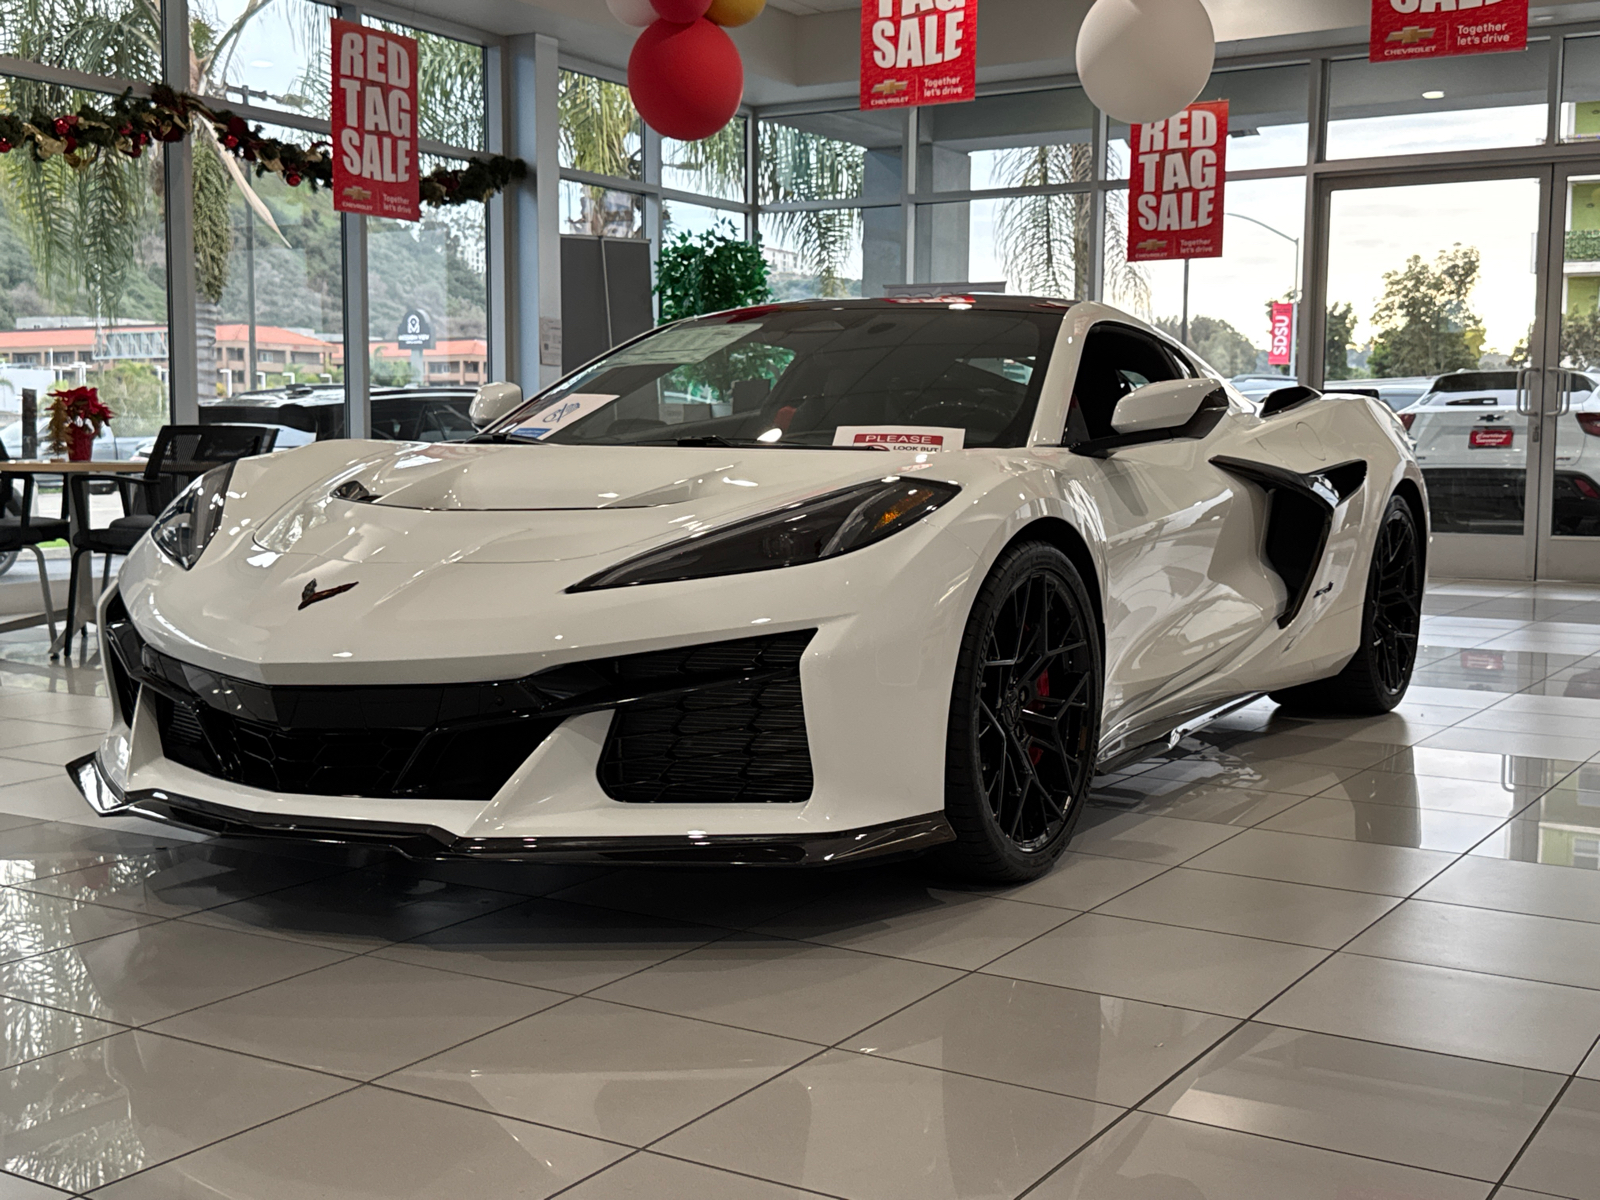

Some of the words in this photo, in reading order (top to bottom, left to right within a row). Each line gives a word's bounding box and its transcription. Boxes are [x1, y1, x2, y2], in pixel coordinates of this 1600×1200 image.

[1457, 22, 1508, 36] Together
[872, 10, 965, 69] SALE
[1457, 35, 1480, 46] let's
[1481, 32, 1510, 44] drive
[1384, 45, 1436, 56] CHEVROLET
[339, 32, 411, 89] RED
[924, 76, 960, 88] Together
[924, 88, 941, 97] let's
[942, 85, 963, 95] drive
[339, 78, 412, 138] TAG
[871, 96, 909, 106] CHEVROLET
[1139, 110, 1218, 152] RED
[341, 128, 411, 183] SALE
[1138, 148, 1217, 193] TAG
[342, 201, 373, 211] CHEVROLET
[382, 193, 410, 205] Together
[1137, 189, 1215, 231] SALE
[1180, 238, 1212, 247] Together
[1272, 315, 1290, 356] SDSU
[865, 434, 932, 444] PLEASE
